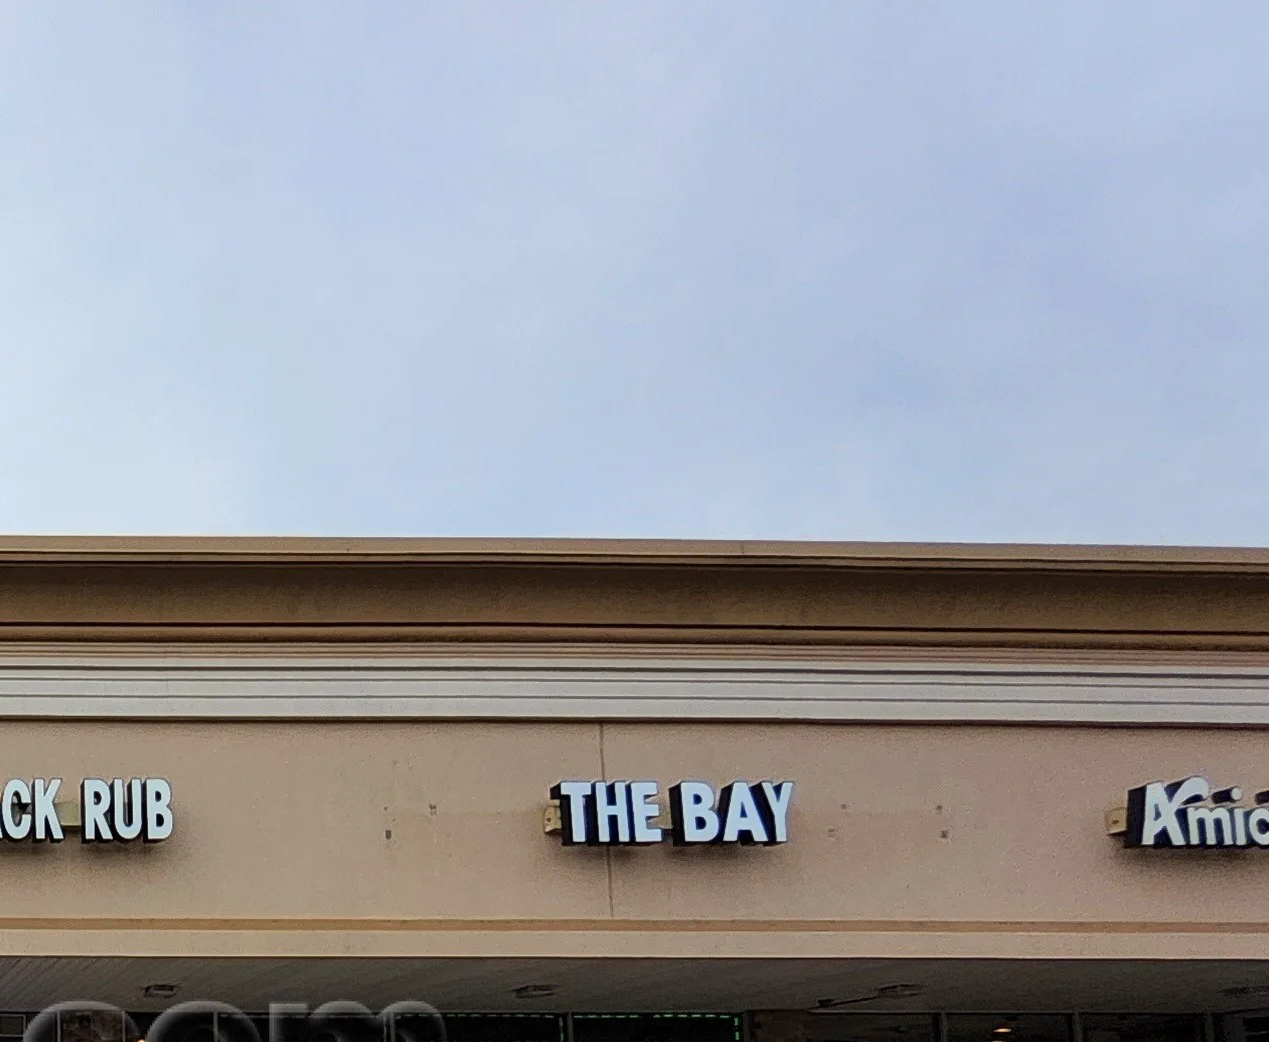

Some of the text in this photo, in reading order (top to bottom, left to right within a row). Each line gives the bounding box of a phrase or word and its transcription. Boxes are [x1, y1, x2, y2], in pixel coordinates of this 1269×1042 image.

[83, 777, 174, 842] RUB
[558, 780, 794, 844] THE BAY
